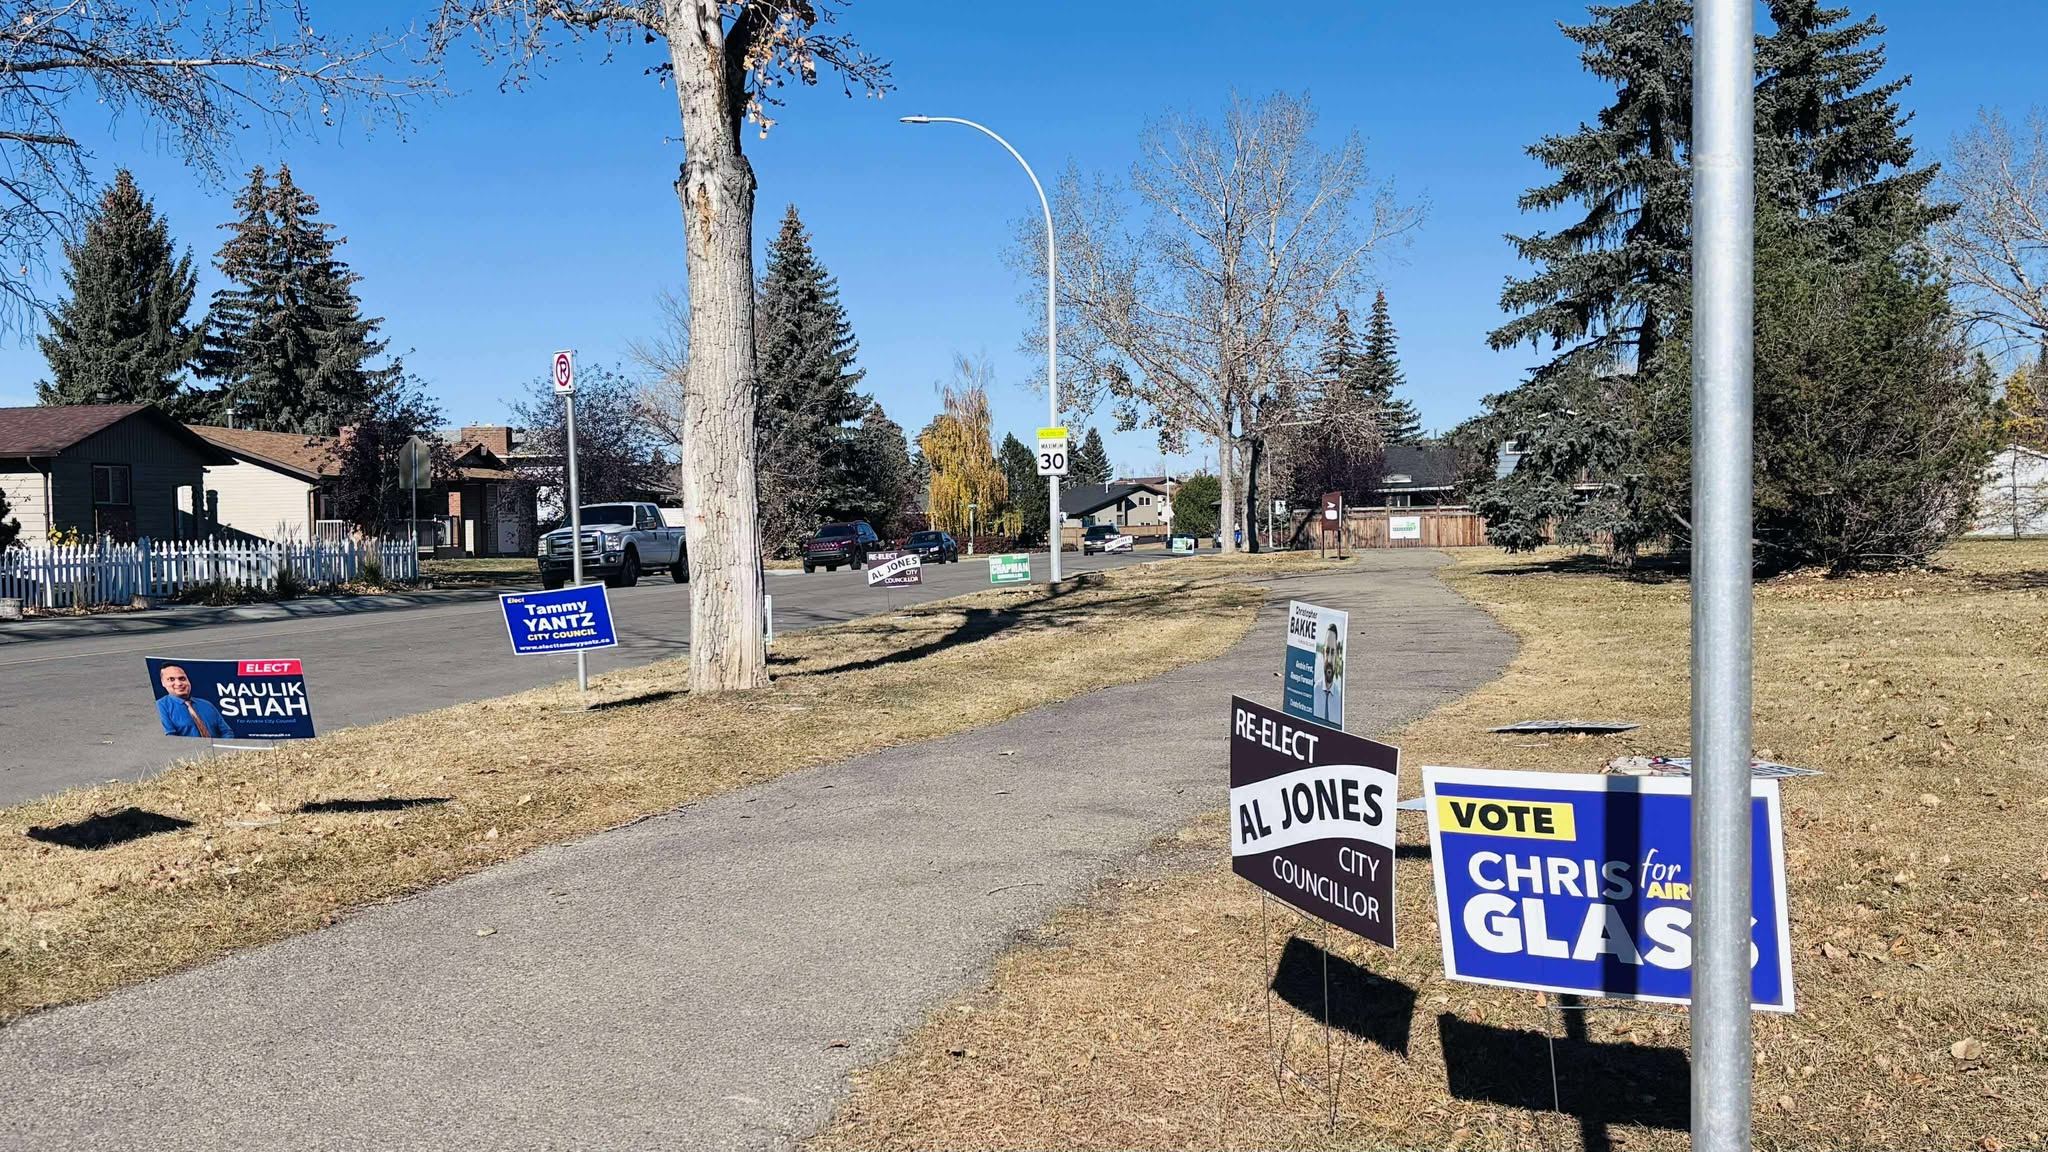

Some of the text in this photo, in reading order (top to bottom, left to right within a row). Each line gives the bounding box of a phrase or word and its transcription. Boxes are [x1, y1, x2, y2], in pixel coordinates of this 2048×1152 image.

[1041, 453, 1064, 470] 30
[868, 552, 898, 561] RE-ELECT
[871, 556, 918, 580] AL JONES
[884, 576, 919, 584] COUNCILLOR
[524, 600, 588, 616] Tammy
[1295, 605, 1318, 619] Christopher
[523, 612, 596, 632] YANTZ
[1290, 616, 1317, 640] BAKKE
[519, 638, 610, 651] www.electtammyyantz.ca
[527, 628, 598, 642] CITY COUNCIL
[245, 663, 292, 673] ELECT
[216, 682, 305, 698] MAULIK
[219, 697, 308, 717] SHAH
[1235, 708, 1319, 764] RE-ELECT
[1239, 778, 1383, 845] AL JONES
[1449, 801, 1555, 834] VOTE
[1338, 846, 1380, 882] CITY
[1467, 848, 1682, 901] CHRIS for
[1272, 855, 1380, 923] COUNCILLOR
[1646, 881, 1693, 901] AIR
[1463, 892, 1760, 970] GLAS
